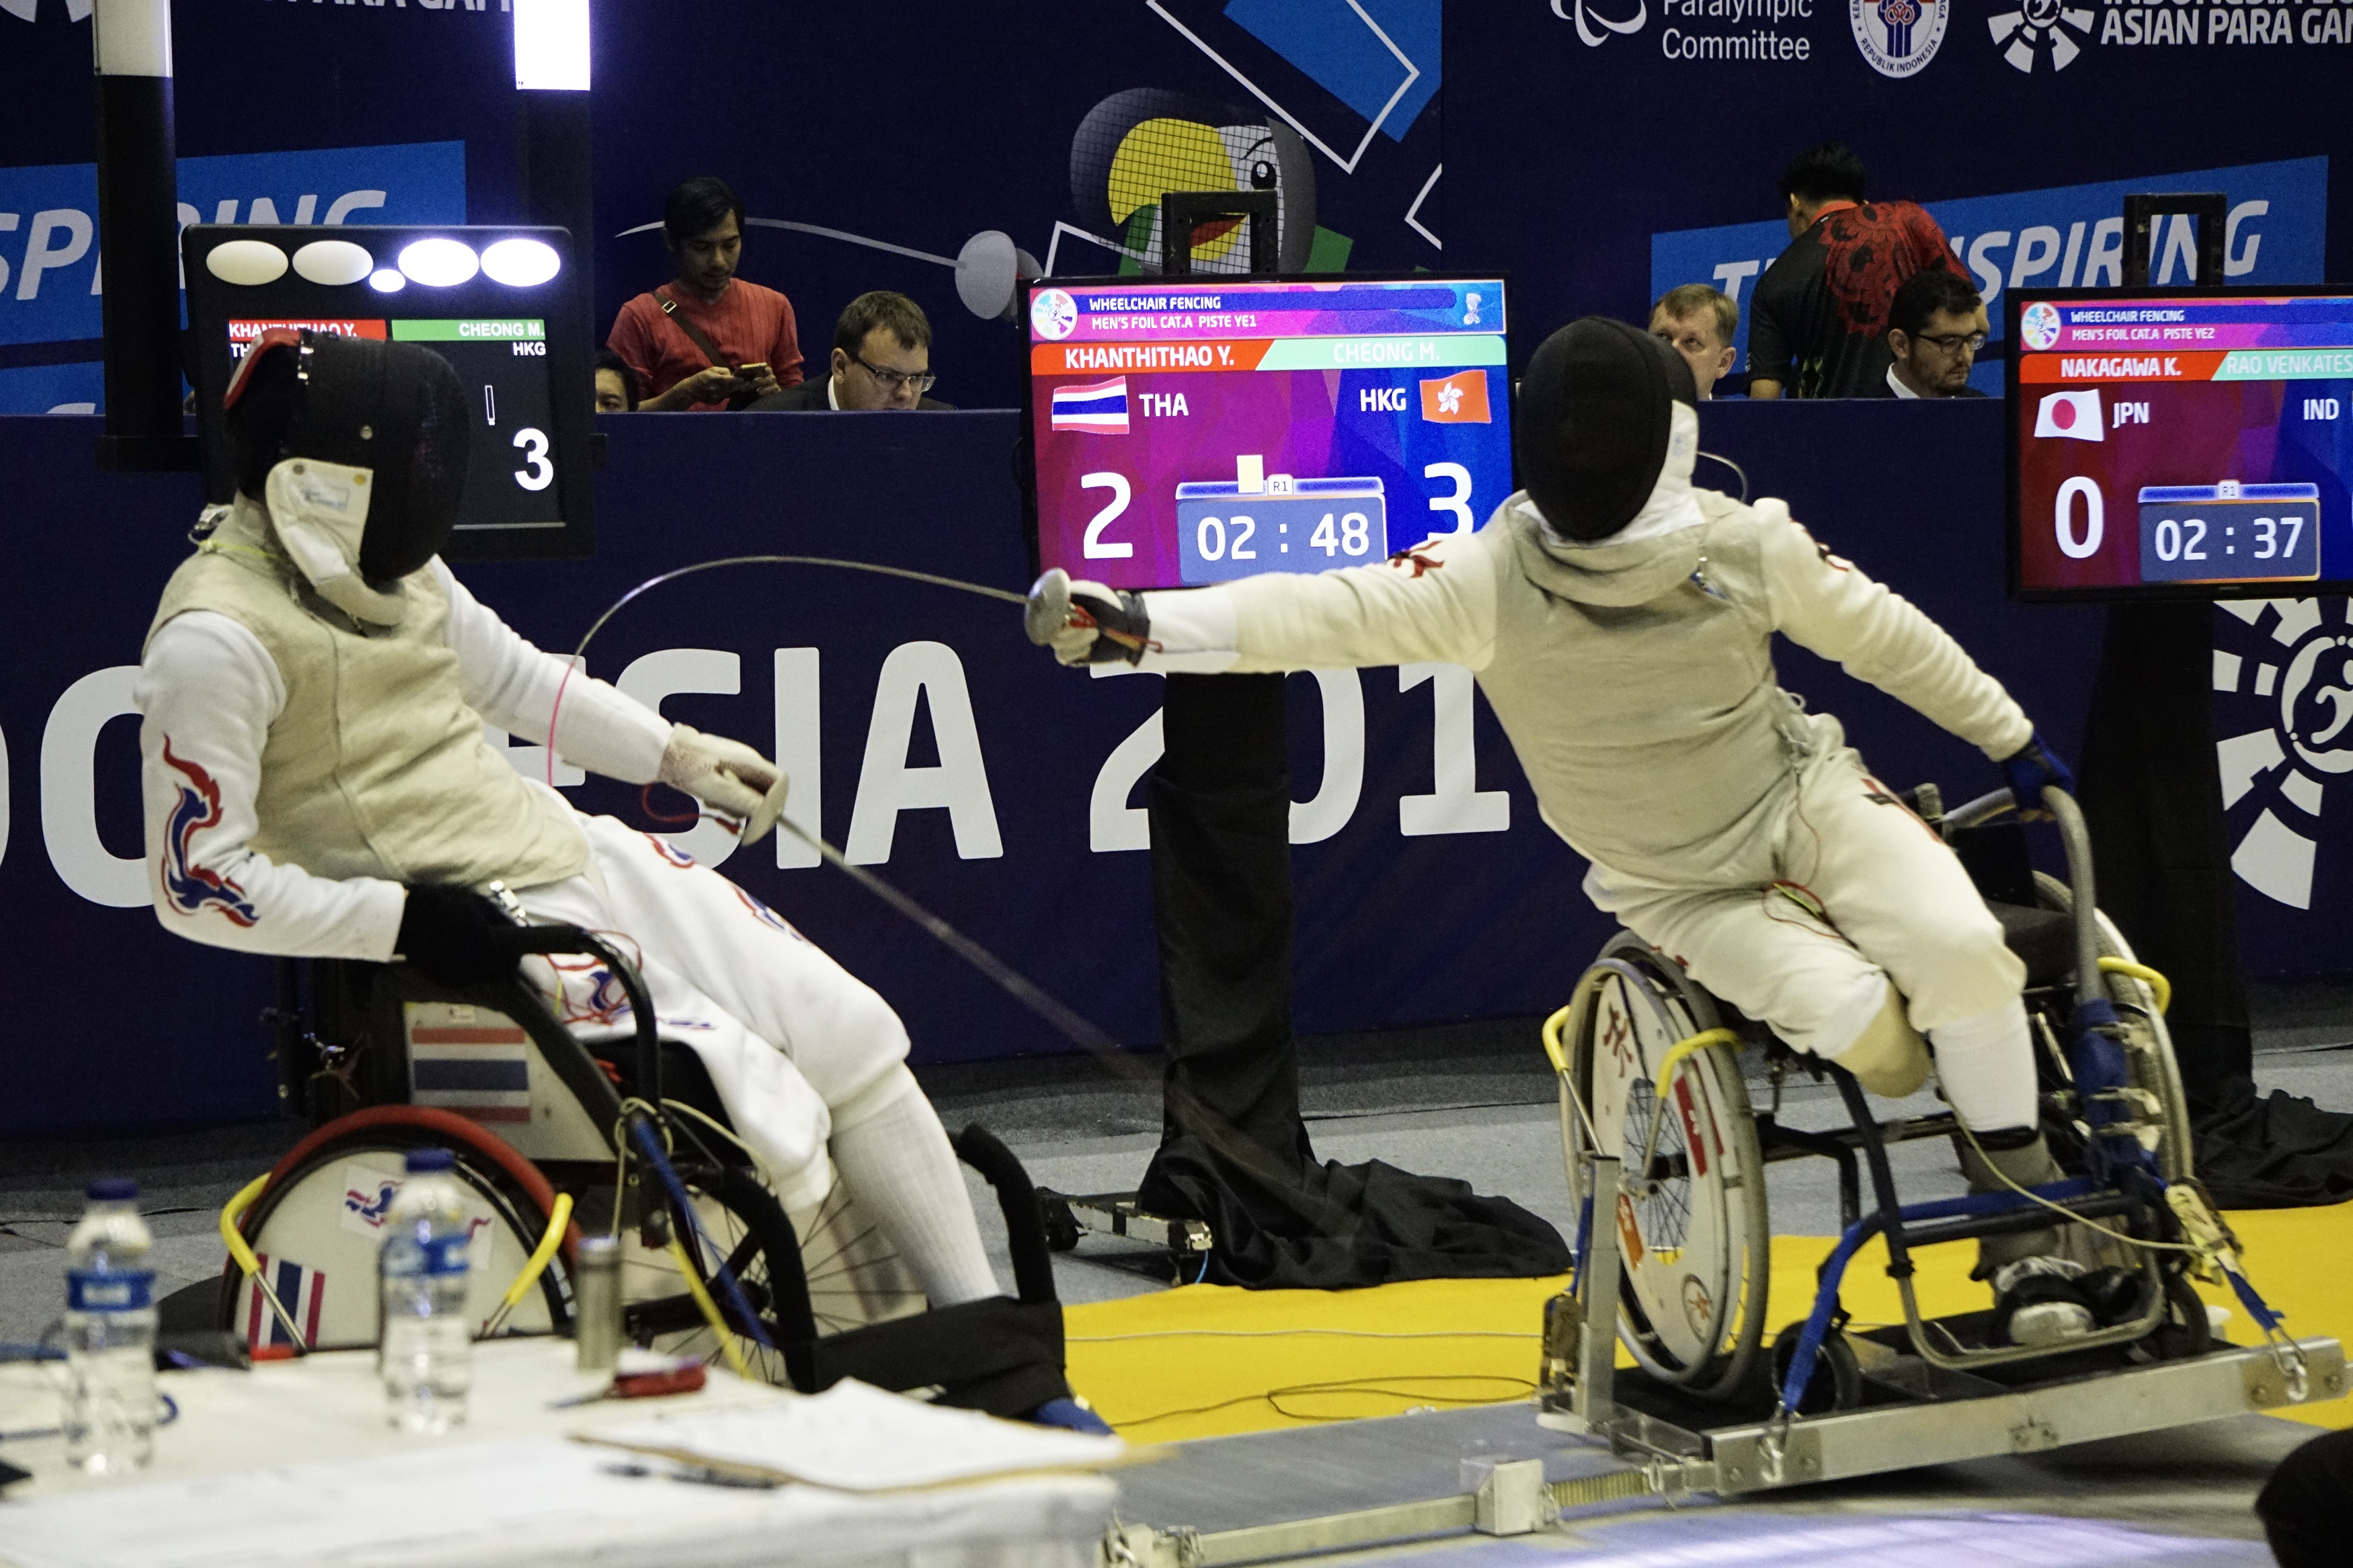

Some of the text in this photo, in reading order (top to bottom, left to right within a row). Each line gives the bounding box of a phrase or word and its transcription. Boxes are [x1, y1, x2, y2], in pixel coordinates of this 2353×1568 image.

[1664, 0, 1812, 24] Paralympic
[2101, 8, 2199, 45] ASIAN
[2208, 8, 2293, 44] PARA
[1663, 28, 1810, 60] Committee
[1861, 38, 1938, 72] REPUBLIK INDONESIA
[1089, 296, 1221, 311] WHEELCHAIR FENCING
[1092, 315, 1257, 329] MEN'S FOIL CAT.A PISTE YE1
[2071, 310, 2184, 323] WHEELCHAIR FENCING
[344, 323, 357, 337] Y.
[459, 323, 545, 336] CHEONG M.
[2073, 329, 2104, 341] MEN'S
[2106, 329, 2129, 340] FOIL
[2163, 328, 2193, 339] PISTE
[2194, 327, 2215, 339] YE2
[513, 341, 547, 356] HKG
[1066, 345, 1234, 368] KHANTHITHAO Y.
[1333, 342, 1440, 363] CHEONG M.
[2061, 358, 2182, 378] NAKAGAWA K.
[2226, 356, 2262, 374] RAO
[1138, 394, 1189, 417] THA
[1360, 388, 1406, 412] HKG
[2303, 399, 2339, 420] IND
[2112, 402, 2149, 429] JPN
[513, 428, 553, 491] 3
[1273, 481, 1287, 491] R1
[1423, 462, 1474, 540] 3
[1081, 472, 1133, 559] 2
[2055, 477, 2104, 559] 0
[1197, 516, 1257, 561] 02
[1310, 513, 1369, 557] 48
[2155, 520, 2207, 561] 02
[2254, 518, 2303, 559] 37
